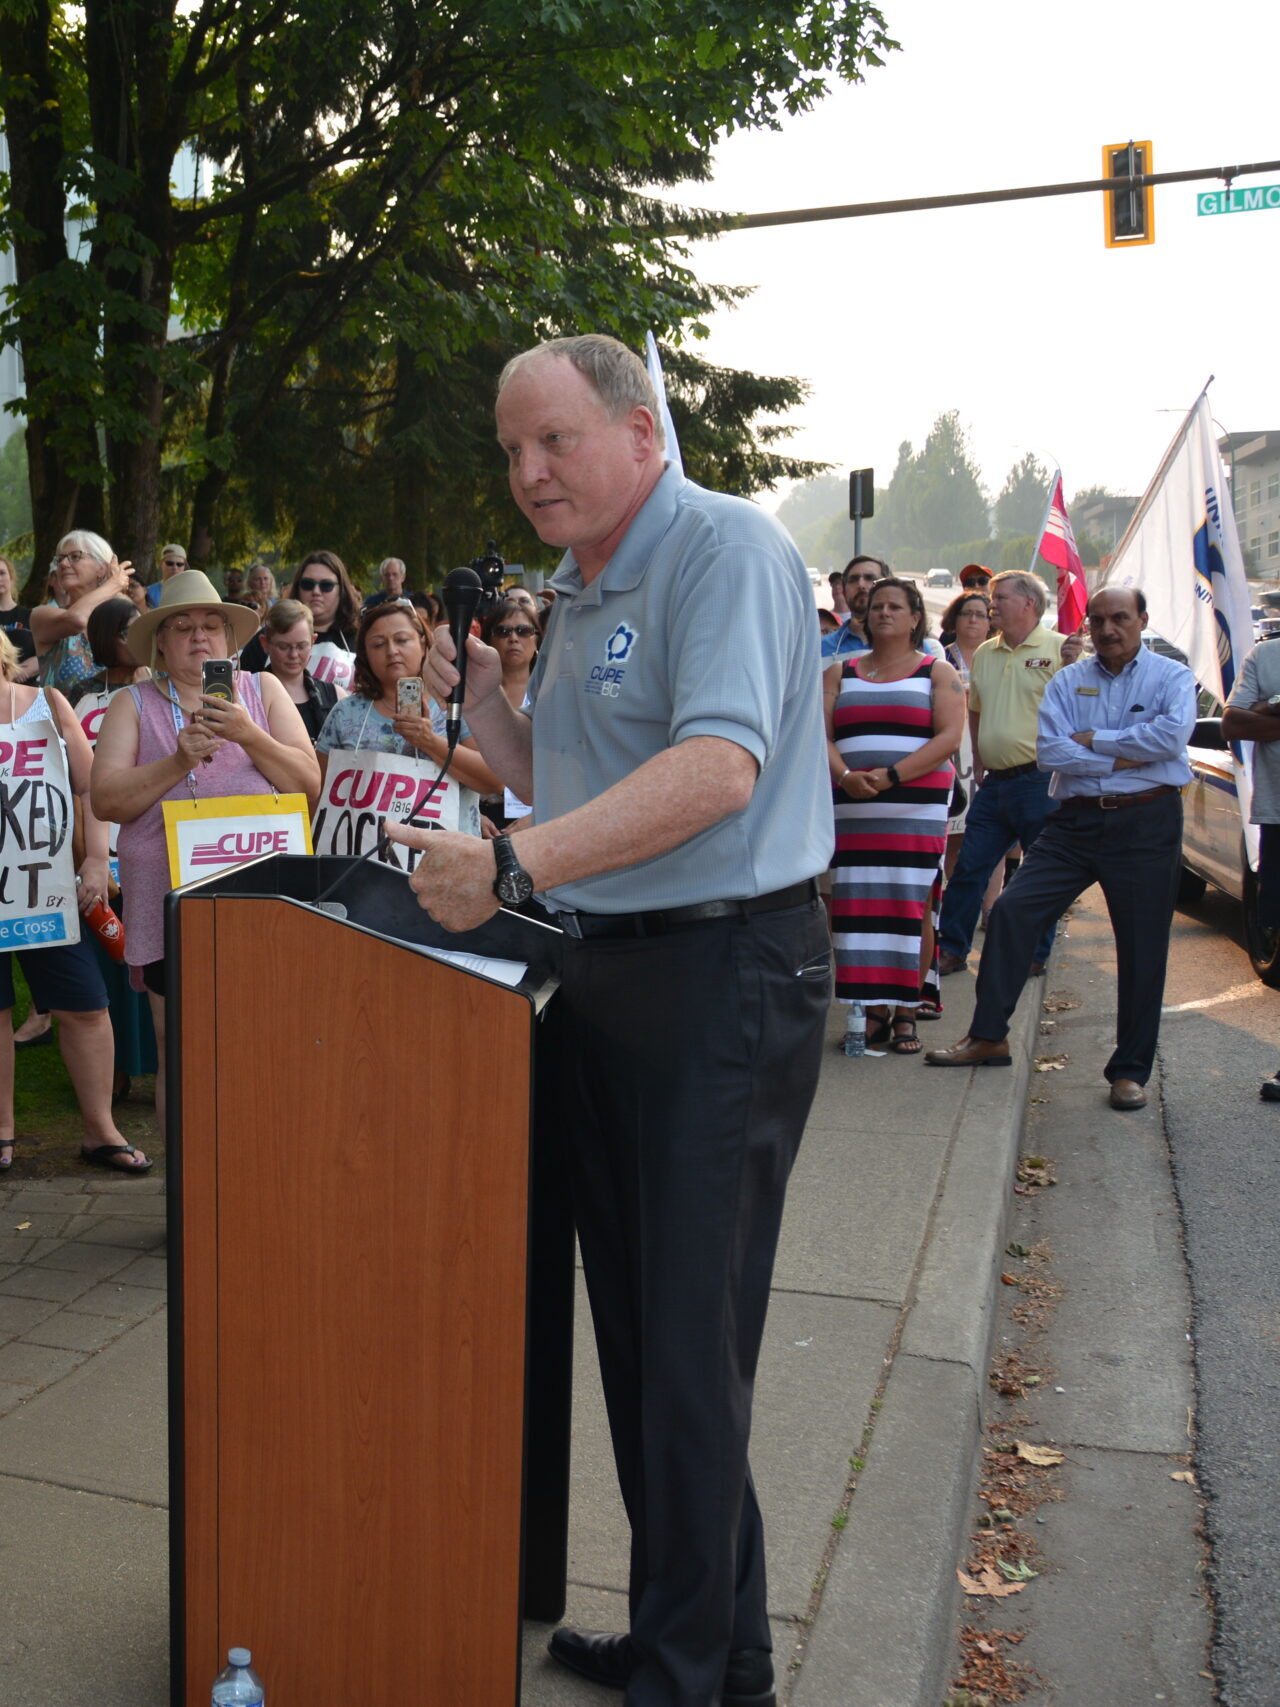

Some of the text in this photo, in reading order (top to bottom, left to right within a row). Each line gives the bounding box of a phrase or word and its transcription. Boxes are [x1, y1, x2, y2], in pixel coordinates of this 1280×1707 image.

[591, 666, 625, 684] CUPE
[601, 682, 620, 697] BC
[328, 768, 449, 819] CUPE
[391, 801, 411, 813] 1816
[217, 831, 288, 855] CUPE
[13, 920, 56, 937] Cross
